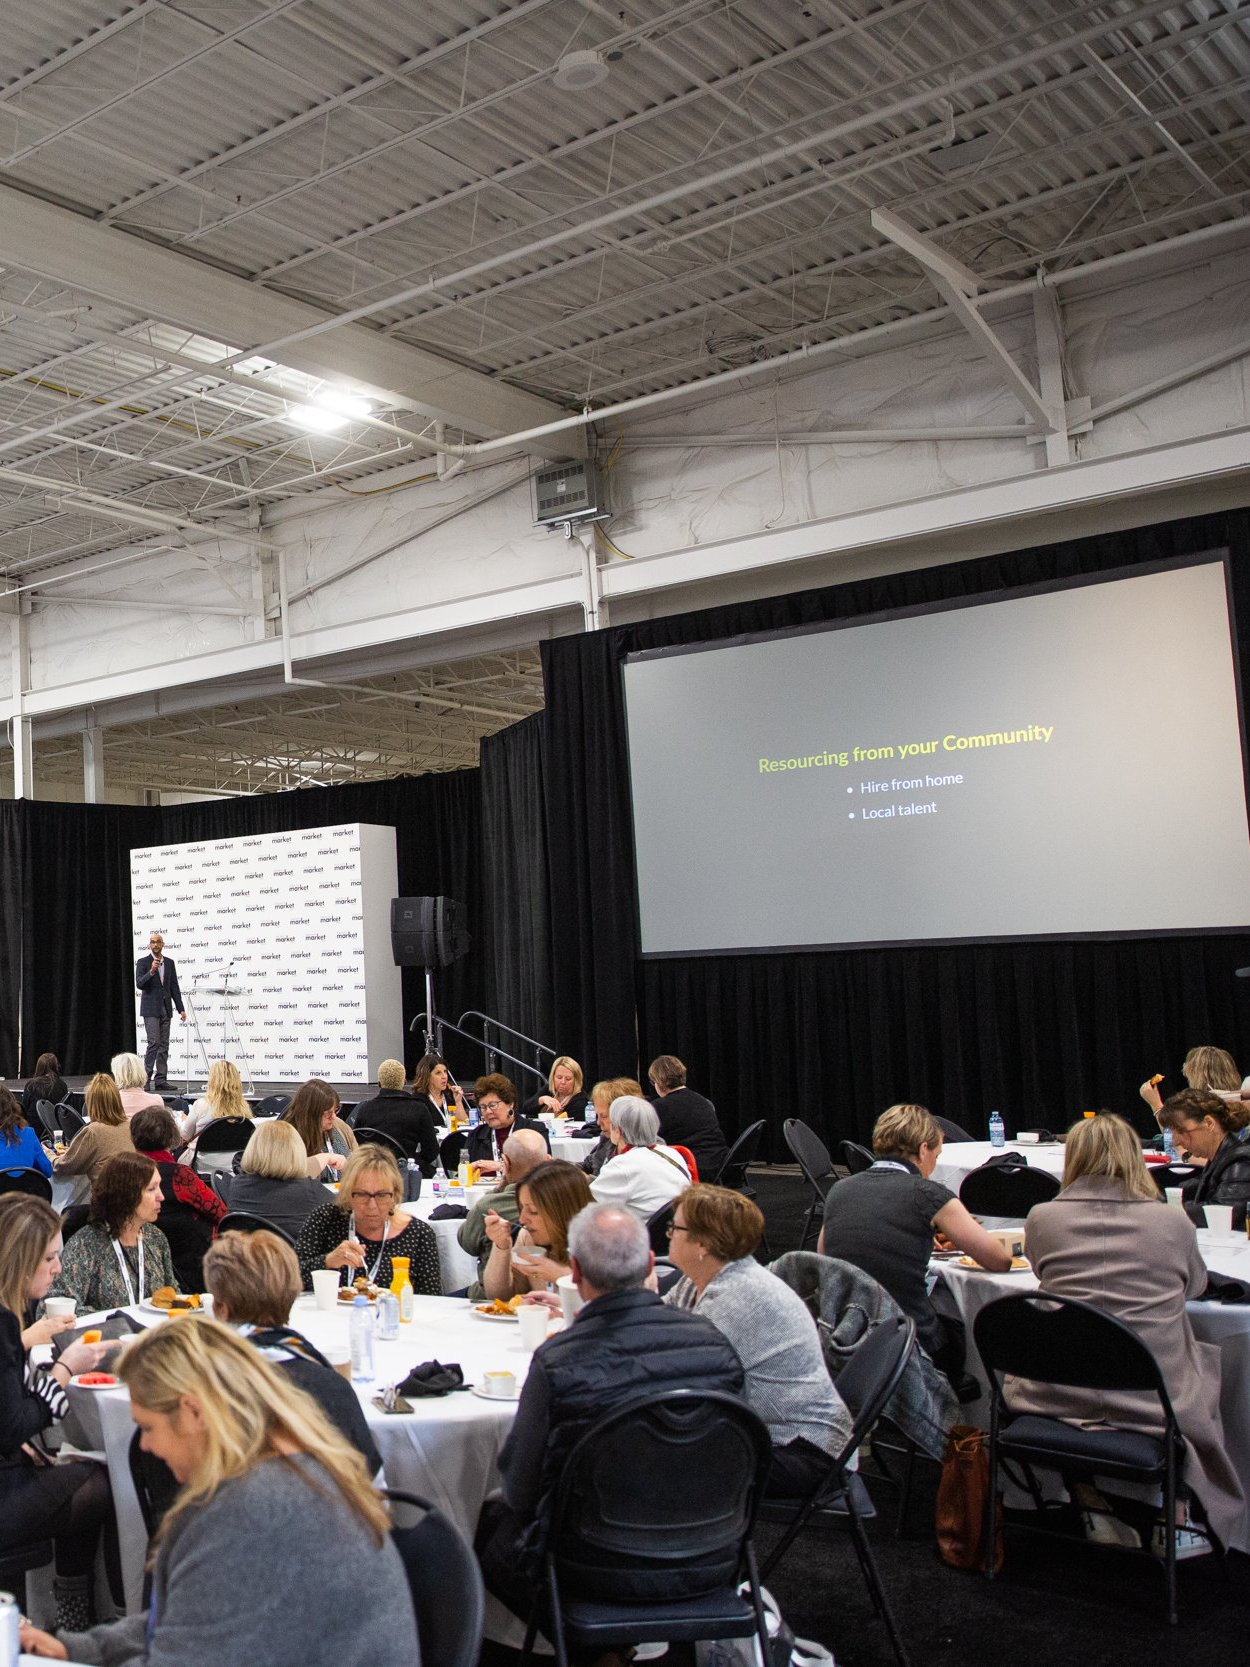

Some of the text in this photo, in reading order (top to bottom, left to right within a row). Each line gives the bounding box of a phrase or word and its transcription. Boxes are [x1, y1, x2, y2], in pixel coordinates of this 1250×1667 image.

[758, 724, 1054, 773] Resourcing from your Community
[860, 772, 964, 794] Hire from home
[862, 801, 938, 820] Local talent
[333, 829, 354, 837] market
[337, 931, 358, 939] market
[220, 1003, 240, 1011] market
[339, 1000, 360, 1008] market
[279, 1035, 299, 1043] market
[235, 1053, 255, 1061] market
